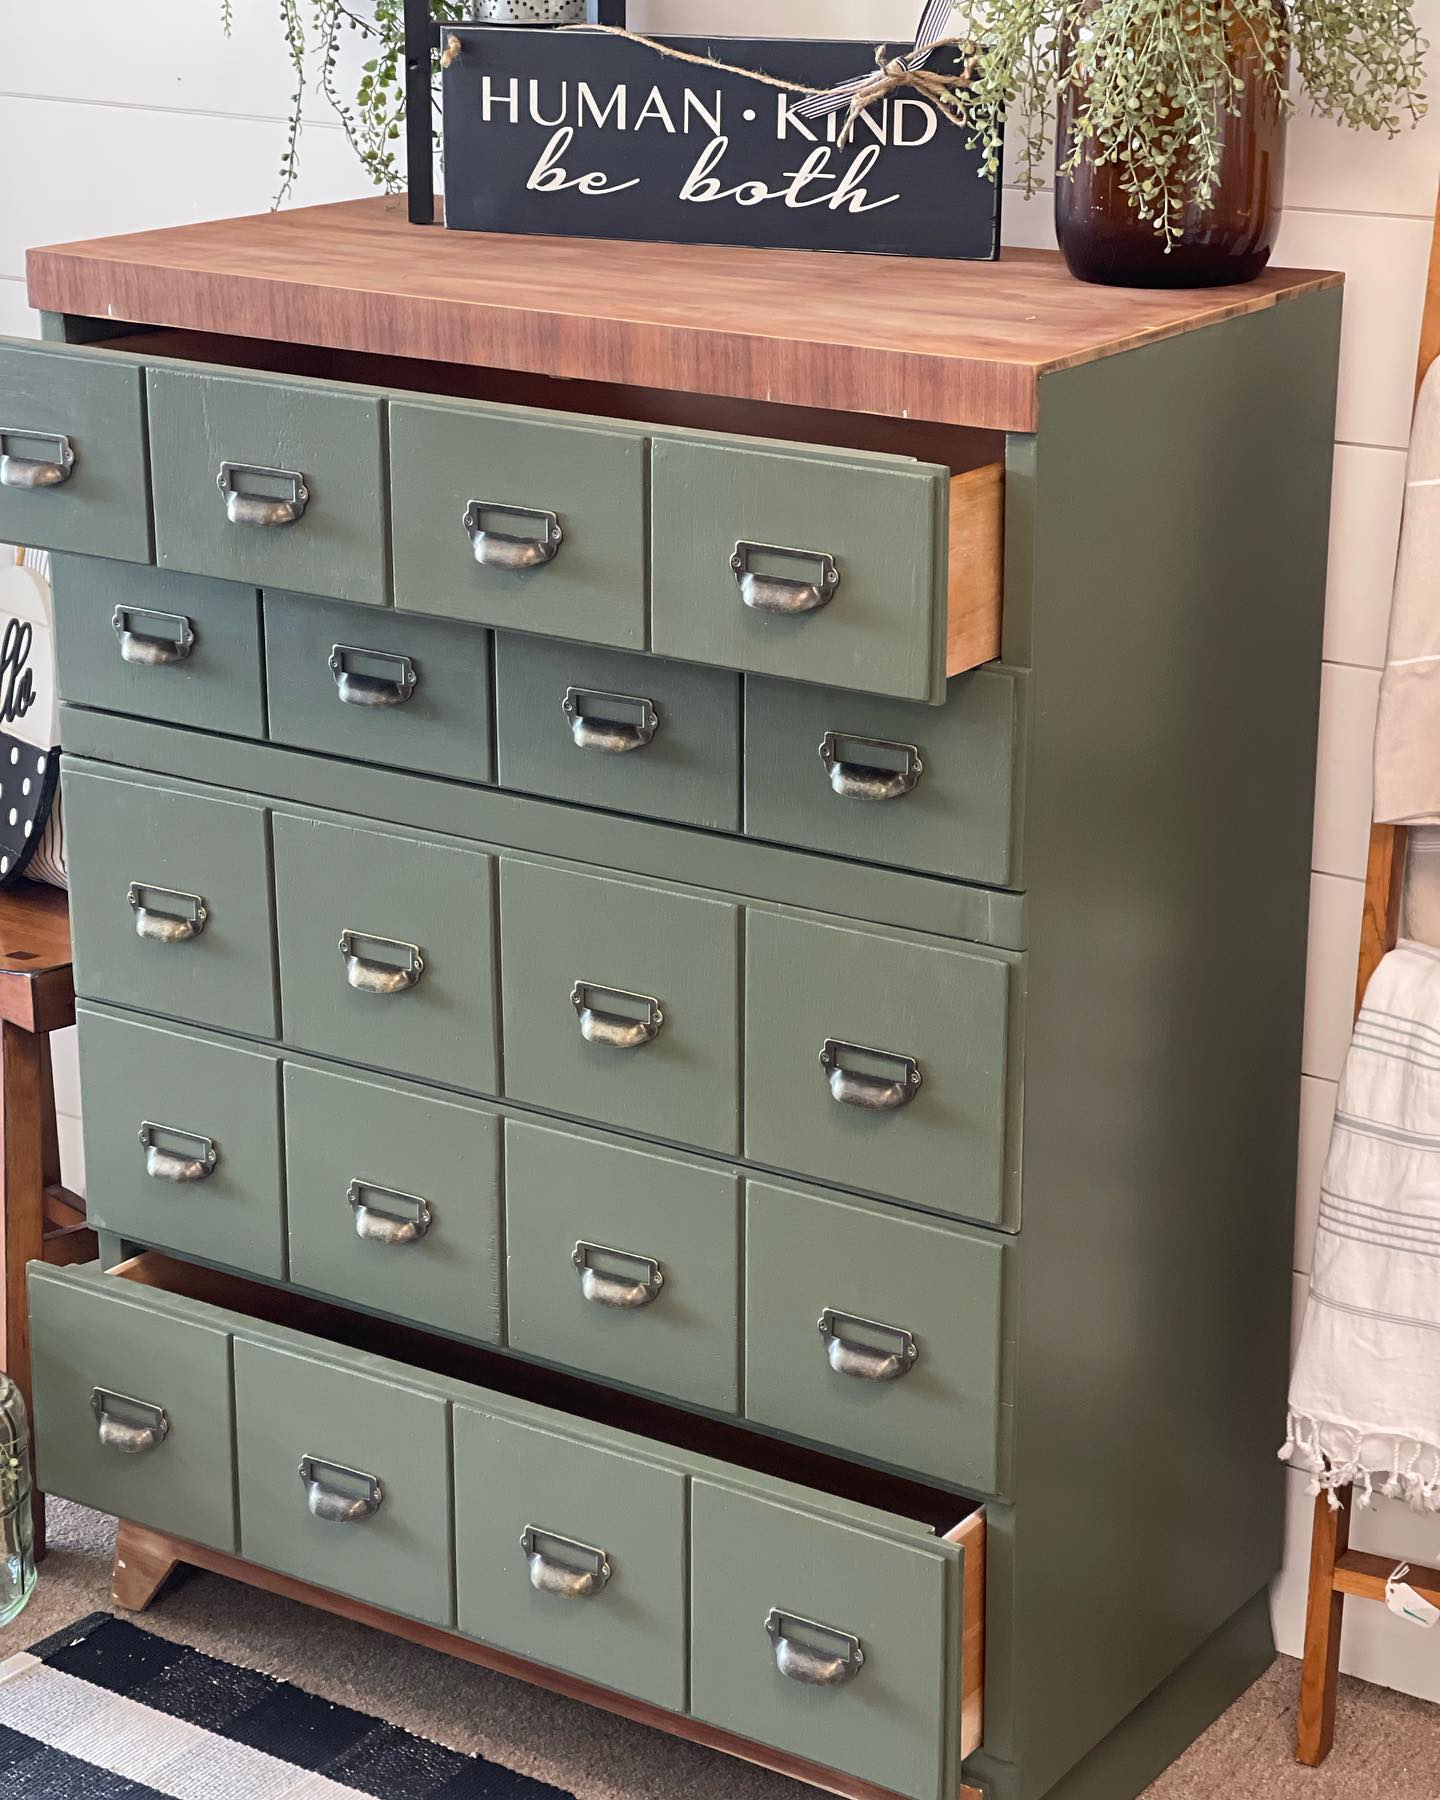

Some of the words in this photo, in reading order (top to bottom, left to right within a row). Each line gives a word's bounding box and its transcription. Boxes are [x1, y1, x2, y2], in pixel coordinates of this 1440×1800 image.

[482, 76, 722, 136] HUMAN
[777, 93, 939, 147] KIND
[526, 126, 641, 195] be
[679, 135, 901, 213] both
